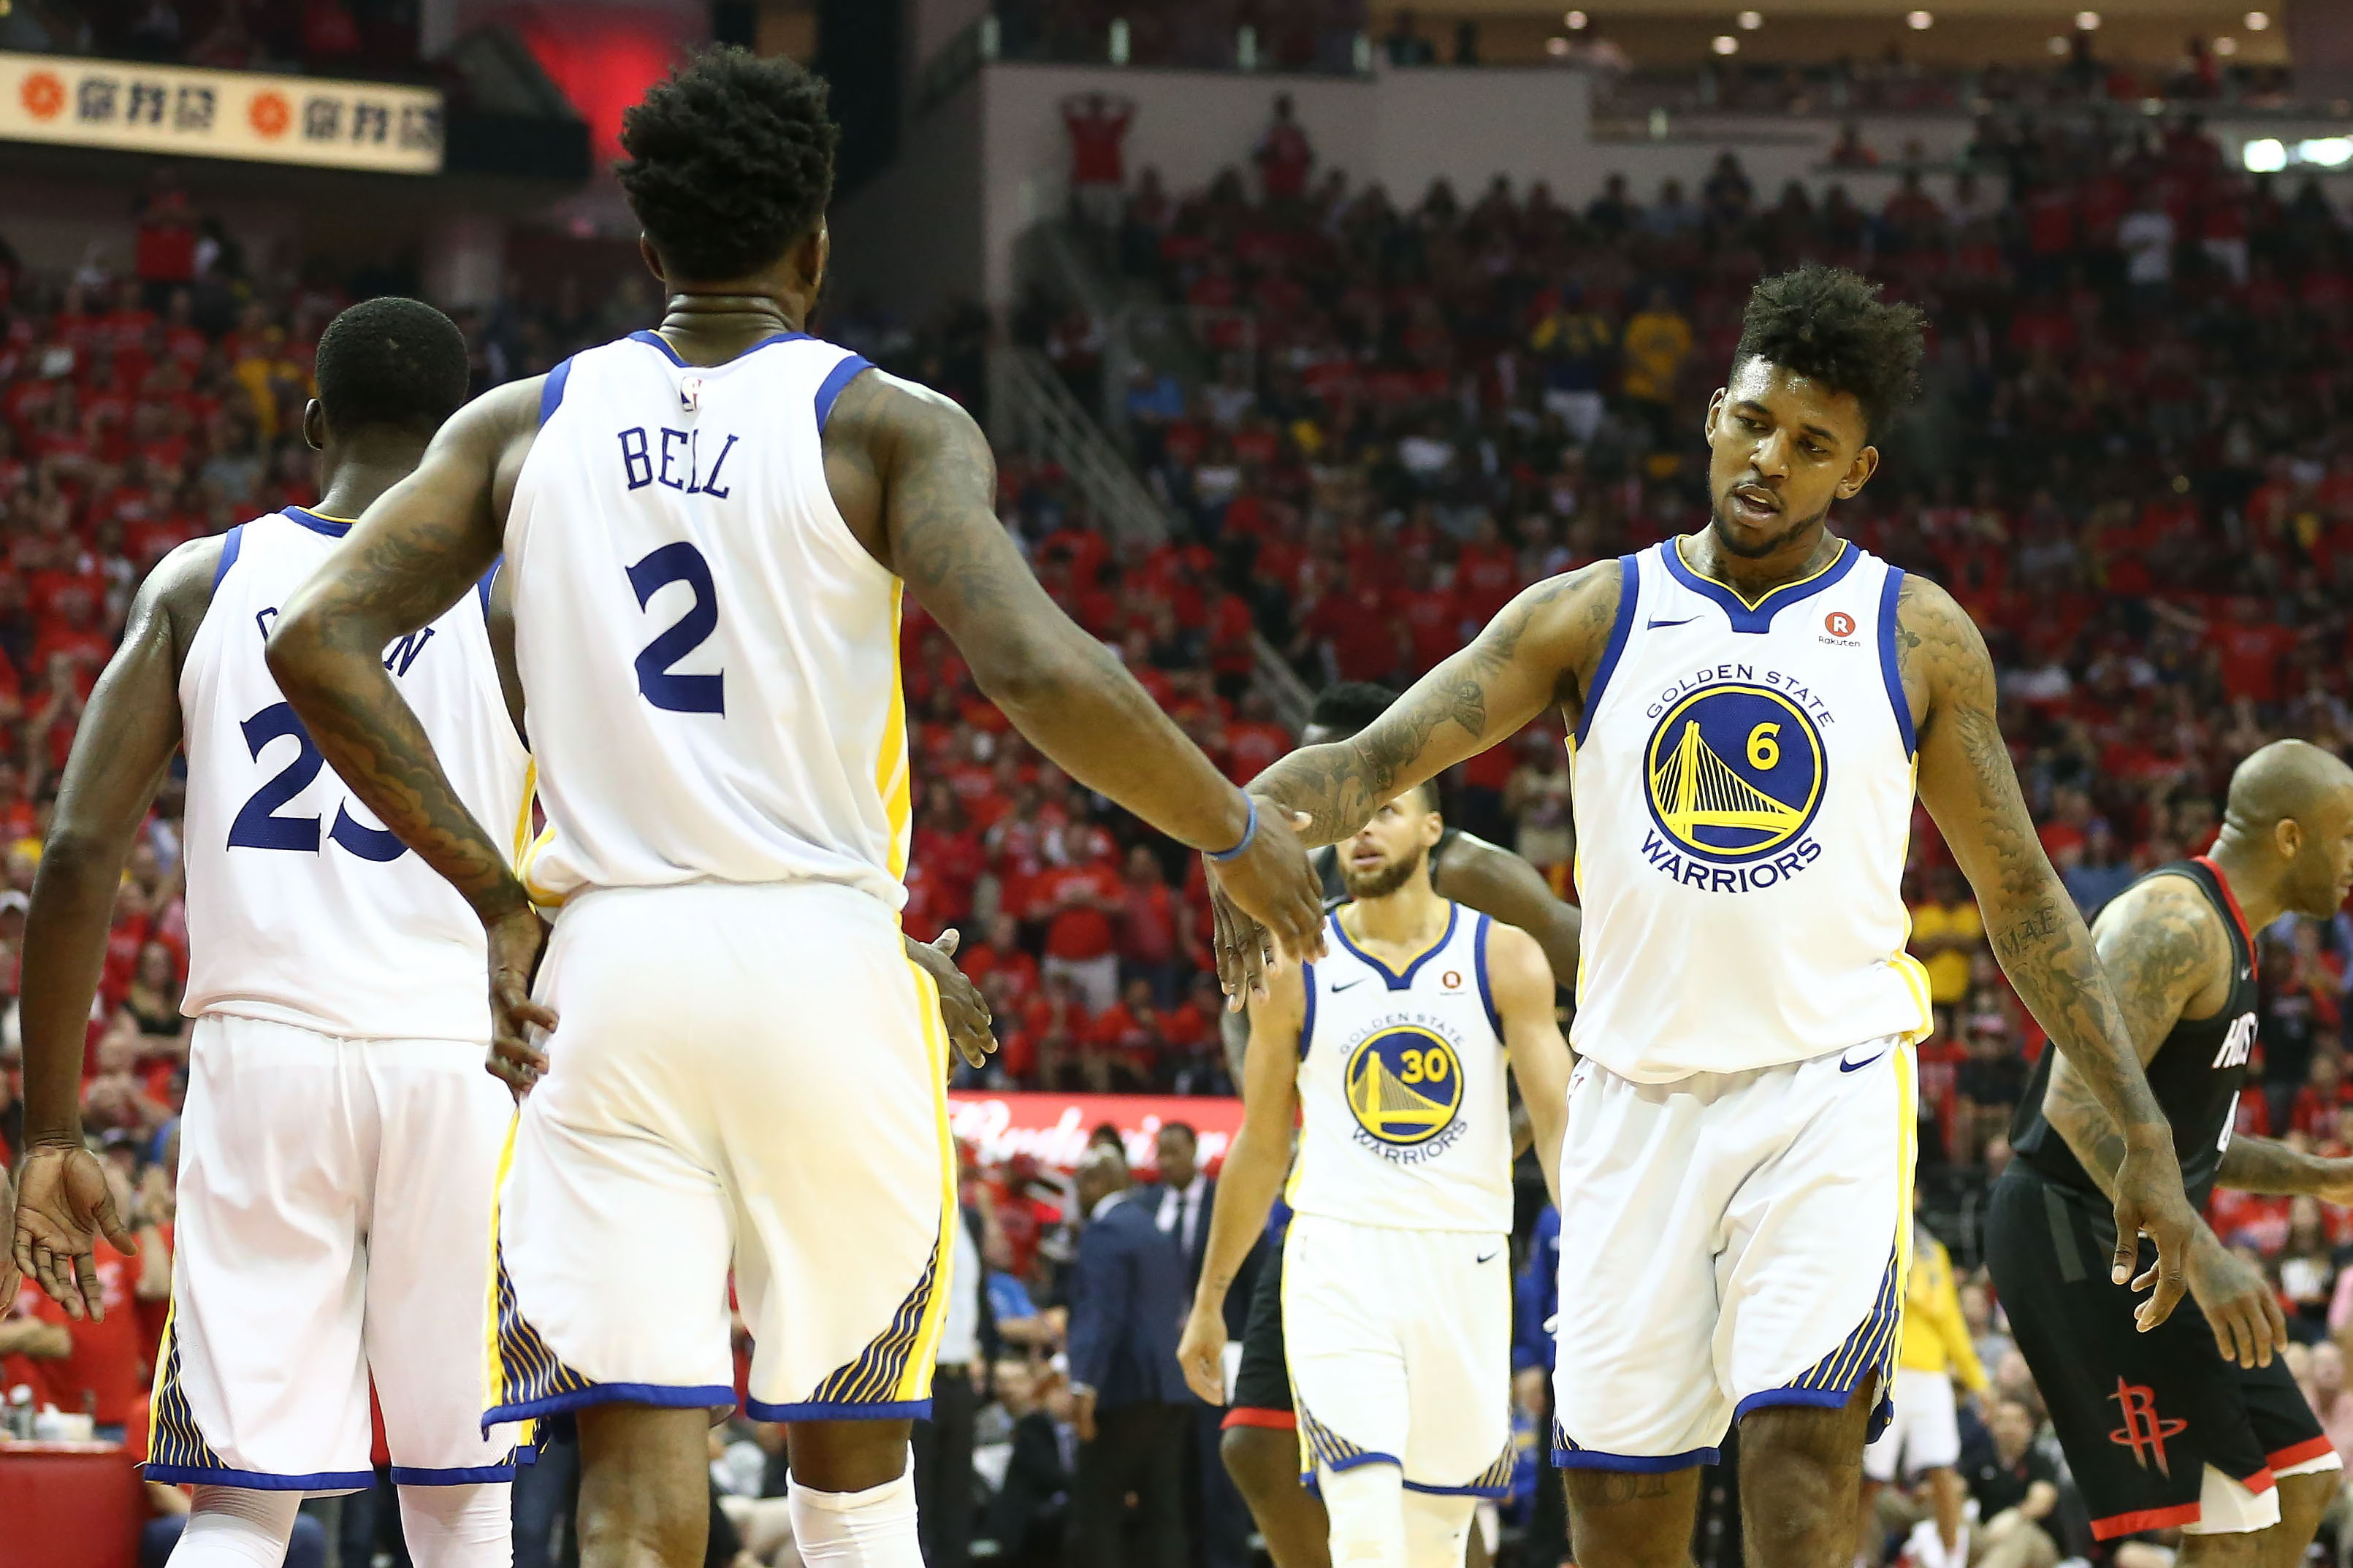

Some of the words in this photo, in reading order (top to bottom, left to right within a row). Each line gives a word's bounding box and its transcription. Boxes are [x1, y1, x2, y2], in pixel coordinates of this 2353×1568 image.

[617, 427, 739, 500] BELL
[625, 541, 725, 719] 2
[1818, 635, 1861, 647] Rakuten
[1647, 664, 1753, 719] GOLDEN
[1766, 670, 1835, 730] STATE
[1746, 722, 1782, 770] 6
[1641, 827, 1823, 894] WARRIORS
[1340, 1012, 1409, 1055] GOLDEN
[1416, 1013, 1465, 1046] STATE
[1400, 1047, 1449, 1085] 30
[1352, 1120, 1468, 1165] WARRIORS
